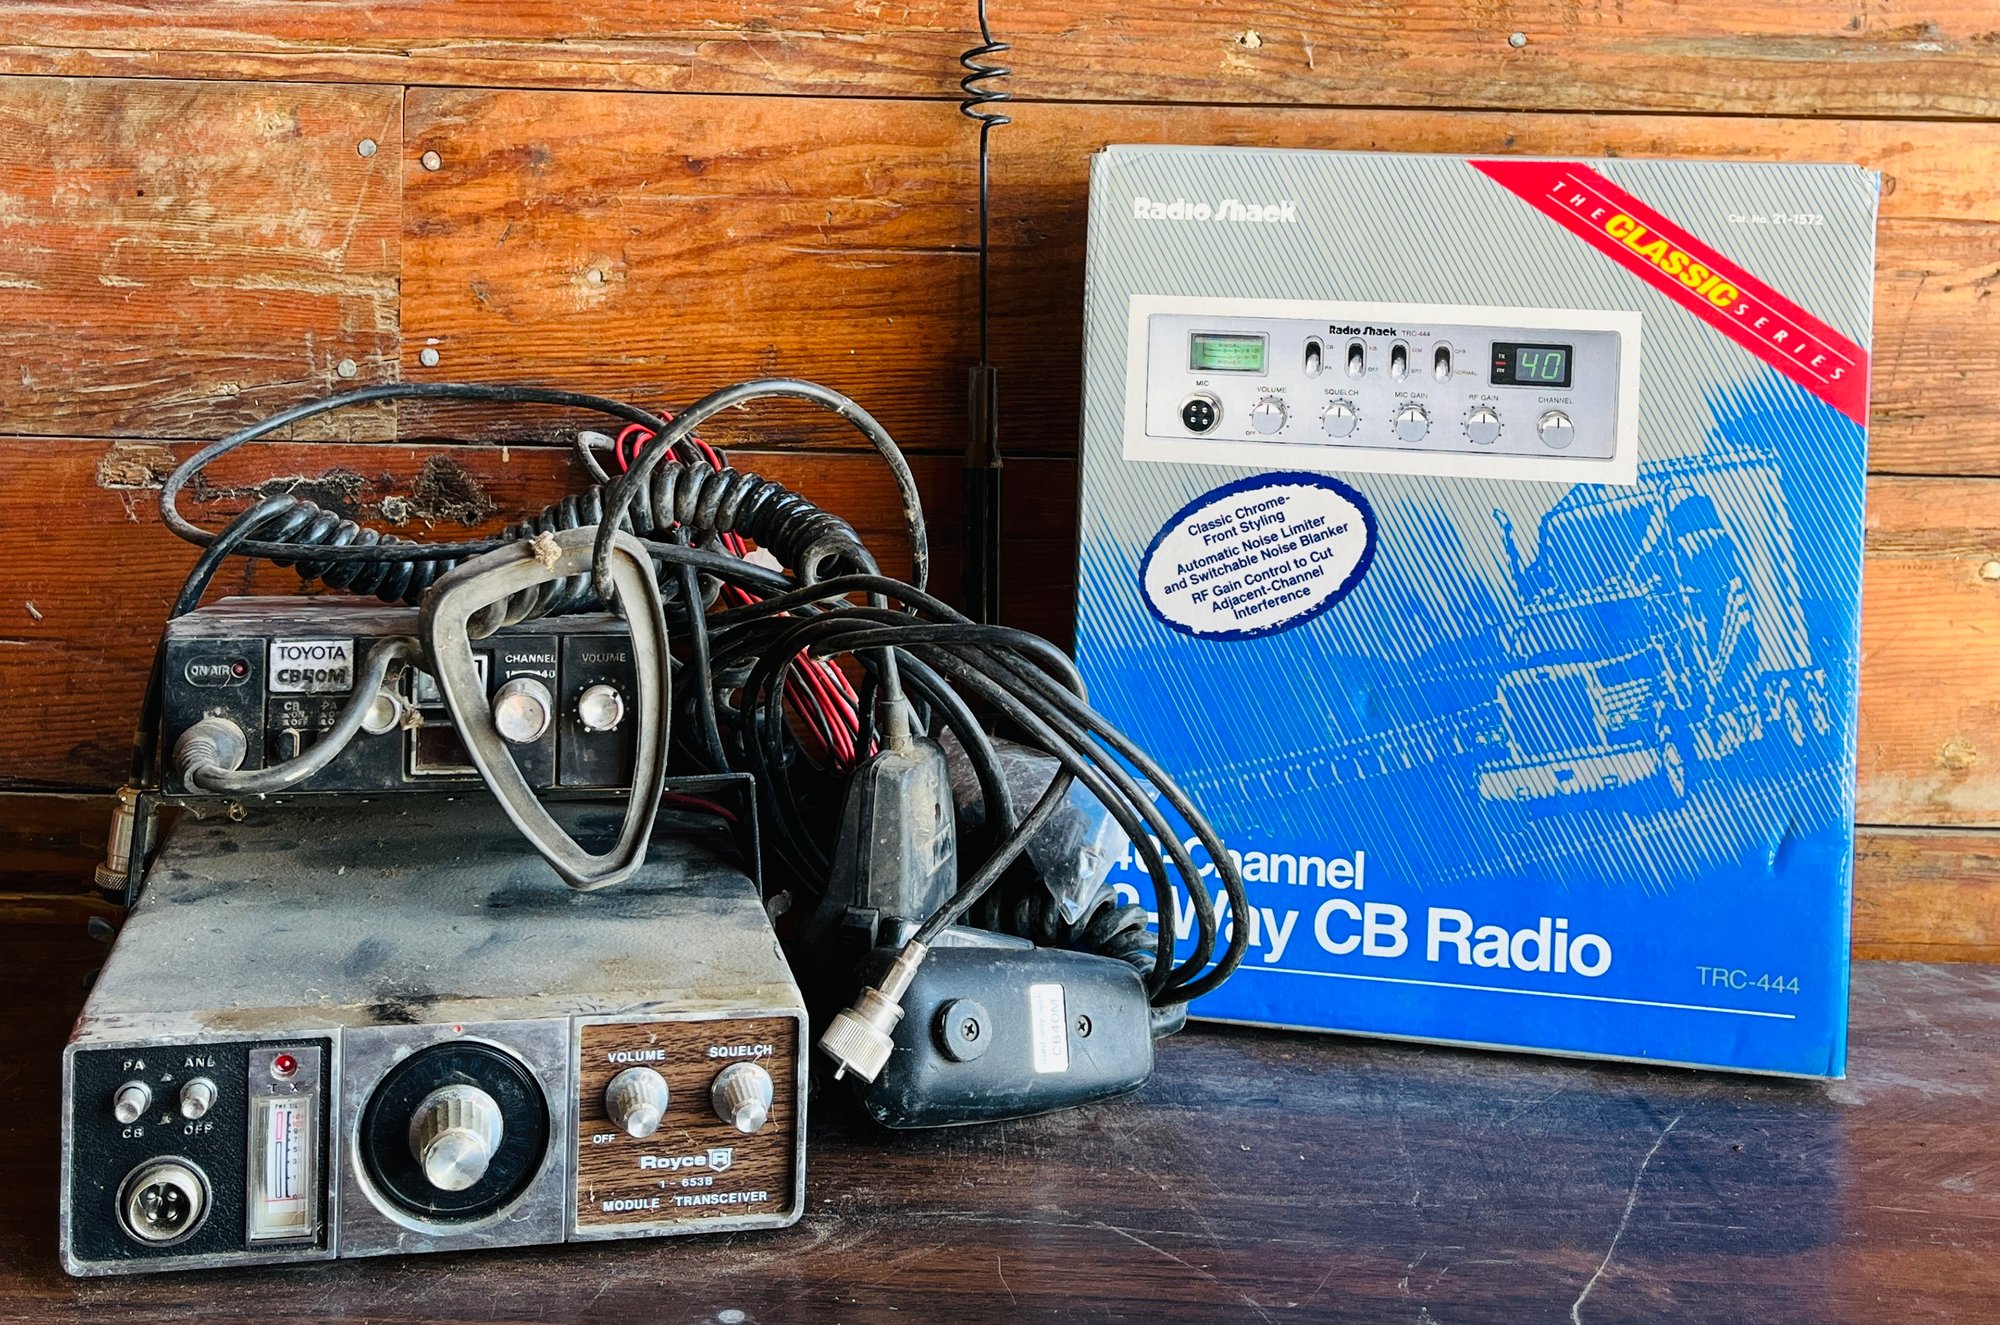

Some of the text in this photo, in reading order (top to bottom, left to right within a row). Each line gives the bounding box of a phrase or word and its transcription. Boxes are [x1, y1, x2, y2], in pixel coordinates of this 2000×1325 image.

[1134, 197, 1211, 221] Radio
[1728, 213, 1824, 226] Cat. No. 21-1572
[1551, 181, 1846, 381] THE CLASSIC SERIES
[1329, 325, 1361, 335] Radio
[1363, 326, 1397, 336] Shack
[1520, 352, 1562, 381] 40
[1257, 386, 1287, 394] VOLUME
[1324, 388, 1359, 396] SQUELCH
[1394, 391, 1408, 399] MIC
[1481, 394, 1499, 402] GAIN
[1538, 396, 1574, 405] CHANNEL
[1188, 494, 1291, 537] Classic Chrome-
[1203, 511, 1286, 547] Front Styling
[1176, 514, 1326, 575] Automatic Noise Limiter
[1163, 521, 1350, 595] and Switchable Noise Blanker
[1191, 546, 1334, 605] RF Gain Control to Cut
[1211, 564, 1325, 613] Adjacent-Channel
[1233, 585, 1311, 620] Interference
[277, 645, 346, 661] TOYOTA
[504, 654, 556, 664] CHANNEL
[581, 652, 627, 663] VOLUME
[190, 665, 230, 676] ON AIR
[283, 701, 300, 711] CB
[1313, 898, 1409, 959] CB
[1426, 907, 1613, 977] Radio
[1695, 965, 1801, 996] TRC-444
[1050, 999, 1062, 1057] CB40M
[607, 1049, 666, 1063] VOLUME
[709, 1044, 773, 1058] SQUELCH
[122, 1059, 145, 1071] PA
[184, 1057, 215, 1068] ANL
[122, 1127, 145, 1139] CB
[183, 1122, 214, 1136] OFF
[592, 1134, 616, 1145] OFF
[640, 1153, 707, 1171] Royce
[603, 1190, 768, 1212] MODULE TRANSCEIVER
